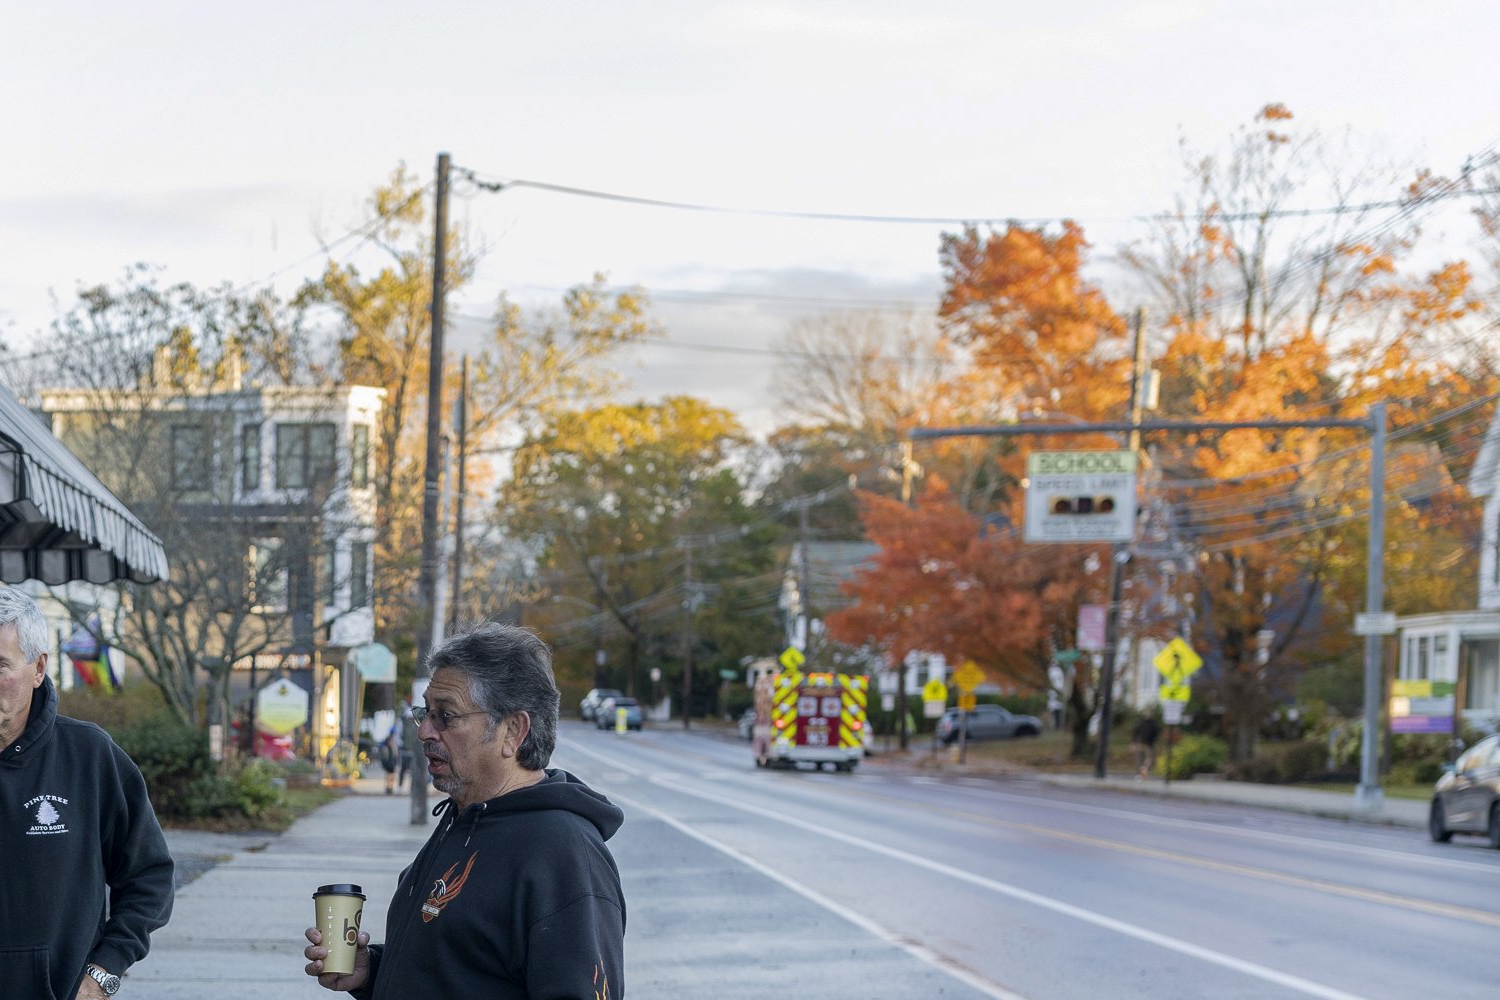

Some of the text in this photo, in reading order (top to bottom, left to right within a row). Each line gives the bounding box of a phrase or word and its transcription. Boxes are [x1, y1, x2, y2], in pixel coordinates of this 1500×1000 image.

[1039, 453, 1126, 473] SCHOOL
[24, 795, 68, 808] PINE TREE
